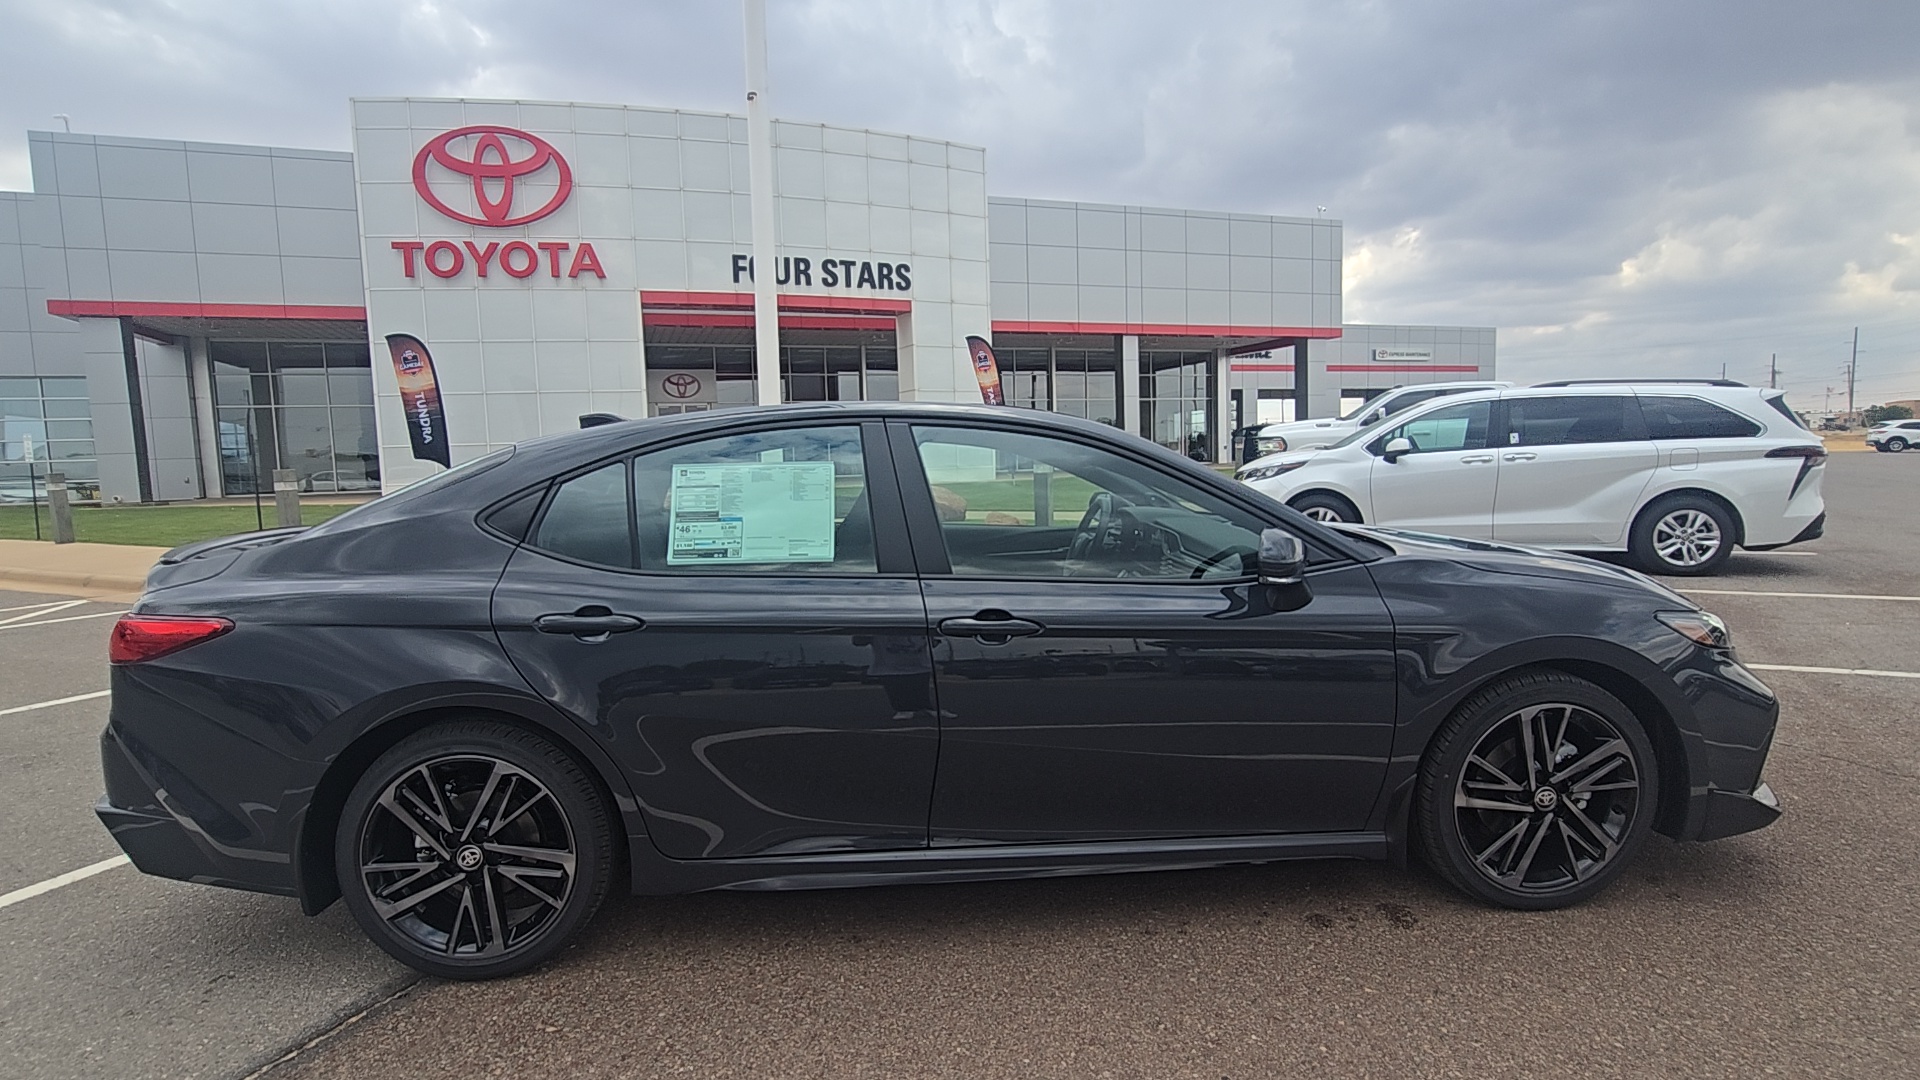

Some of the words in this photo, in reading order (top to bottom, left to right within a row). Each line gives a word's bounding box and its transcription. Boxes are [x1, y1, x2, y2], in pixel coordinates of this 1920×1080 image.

[391, 240, 607, 279] TOYOTA
[732, 254, 812, 287] FUR
[821, 258, 912, 292] STARS
[414, 391, 433, 444] TUNDRA
